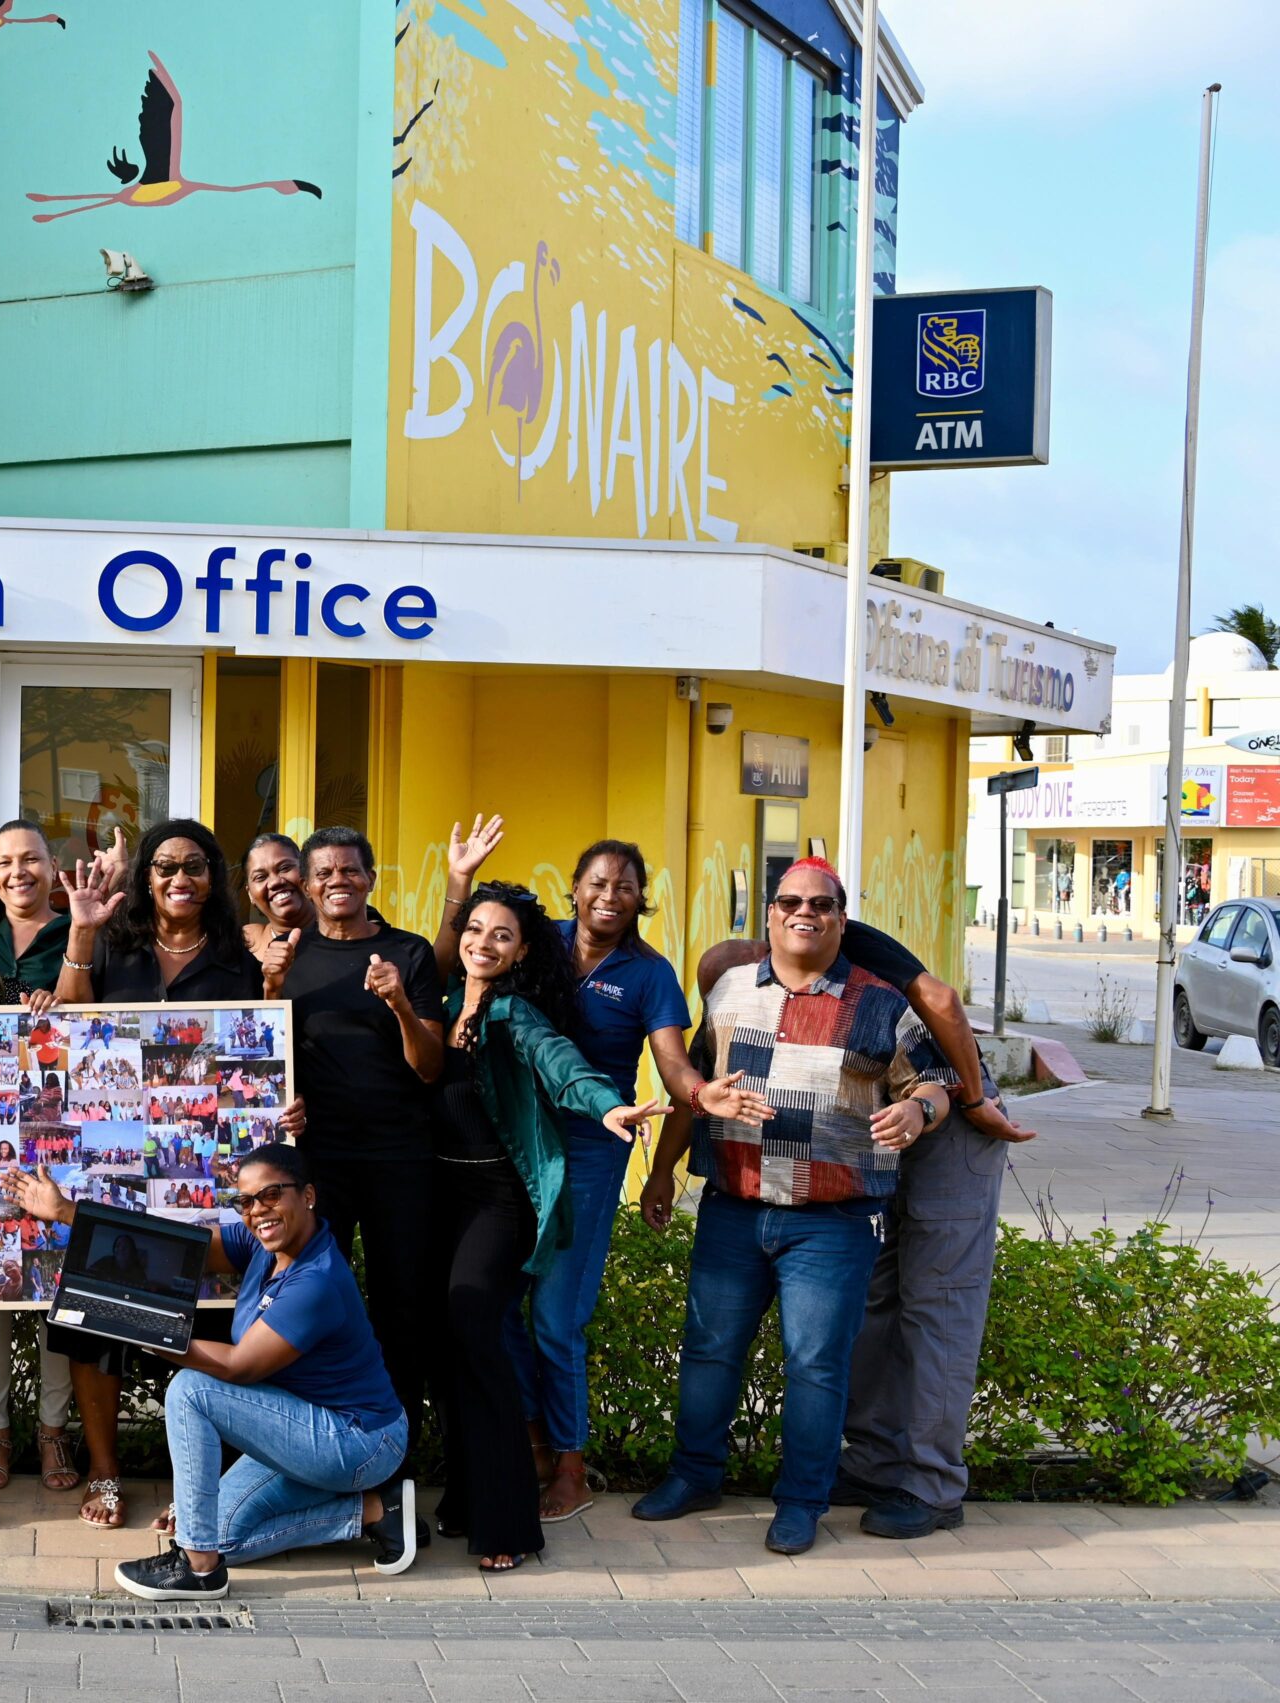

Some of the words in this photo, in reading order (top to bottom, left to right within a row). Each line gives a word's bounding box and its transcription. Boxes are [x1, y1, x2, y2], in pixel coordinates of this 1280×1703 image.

[404, 198, 738, 542] BONAIRE
[925, 370, 977, 391] RBC
[915, 420, 984, 451] ATM
[98, 546, 438, 640] Office
[956, 621, 983, 693] di
[987, 631, 1074, 713] Turismo
[770, 748, 801, 786] ATM
[1230, 775, 1256, 784] Today
[1044, 781, 1073, 818] DIVE
